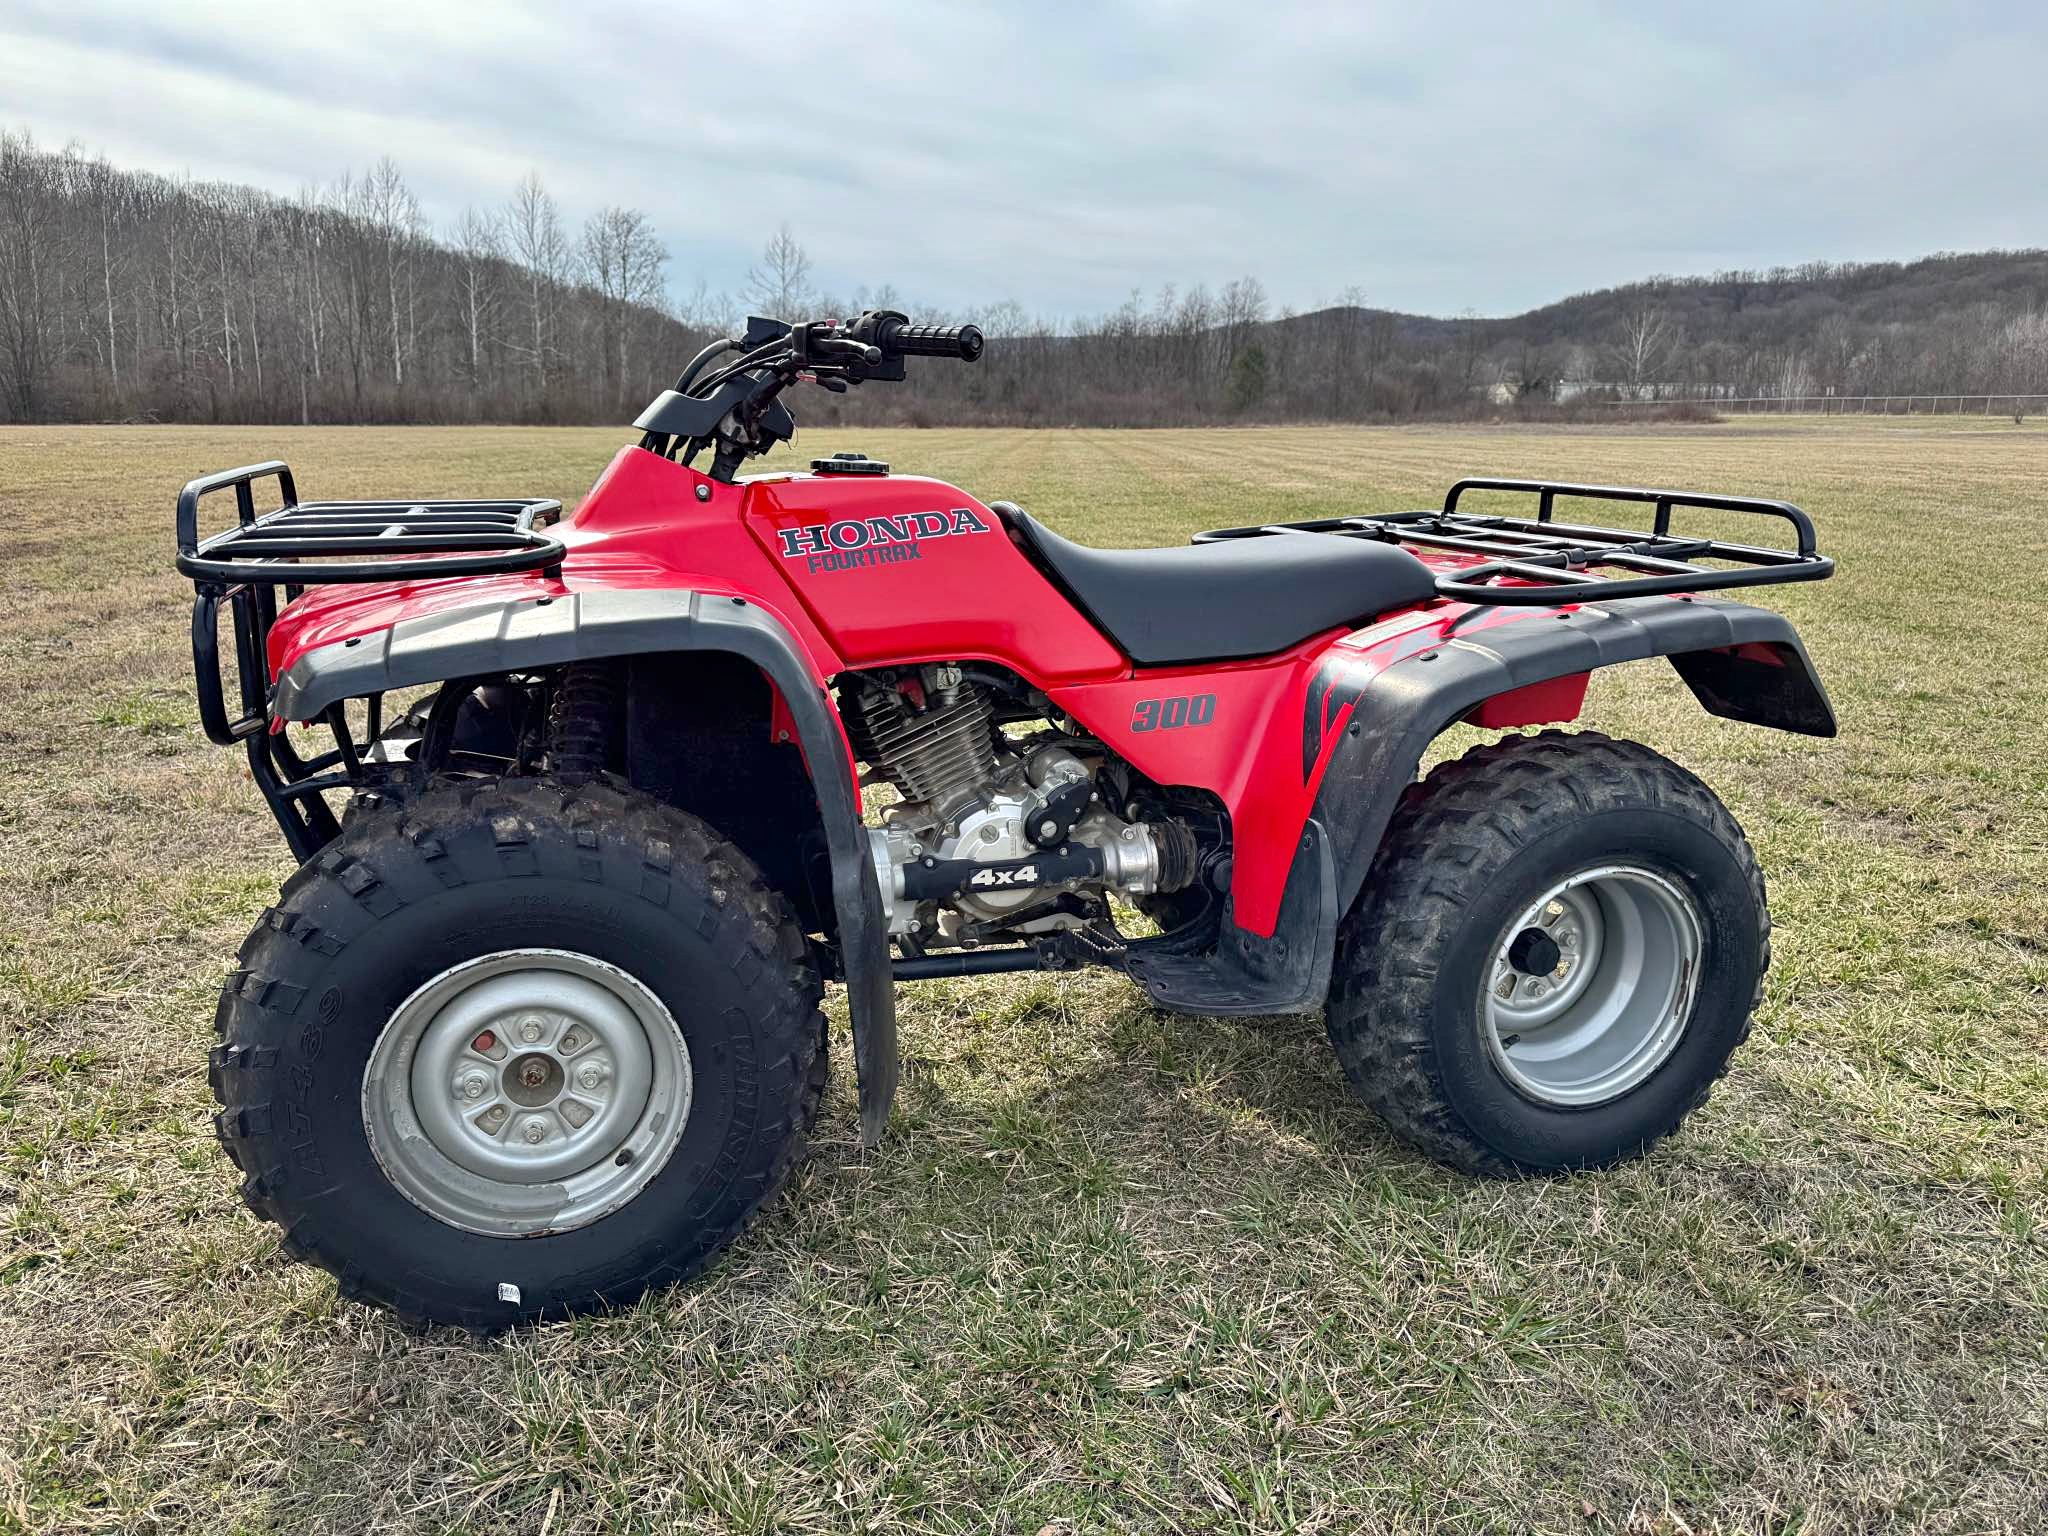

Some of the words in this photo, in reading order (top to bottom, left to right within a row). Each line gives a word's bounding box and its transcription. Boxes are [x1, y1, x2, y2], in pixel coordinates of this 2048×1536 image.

[777, 508, 989, 557] HONDA
[807, 542, 922, 575] FOURTRAX
[1130, 693, 1217, 733] 300
[971, 865, 1038, 886] 4x4
